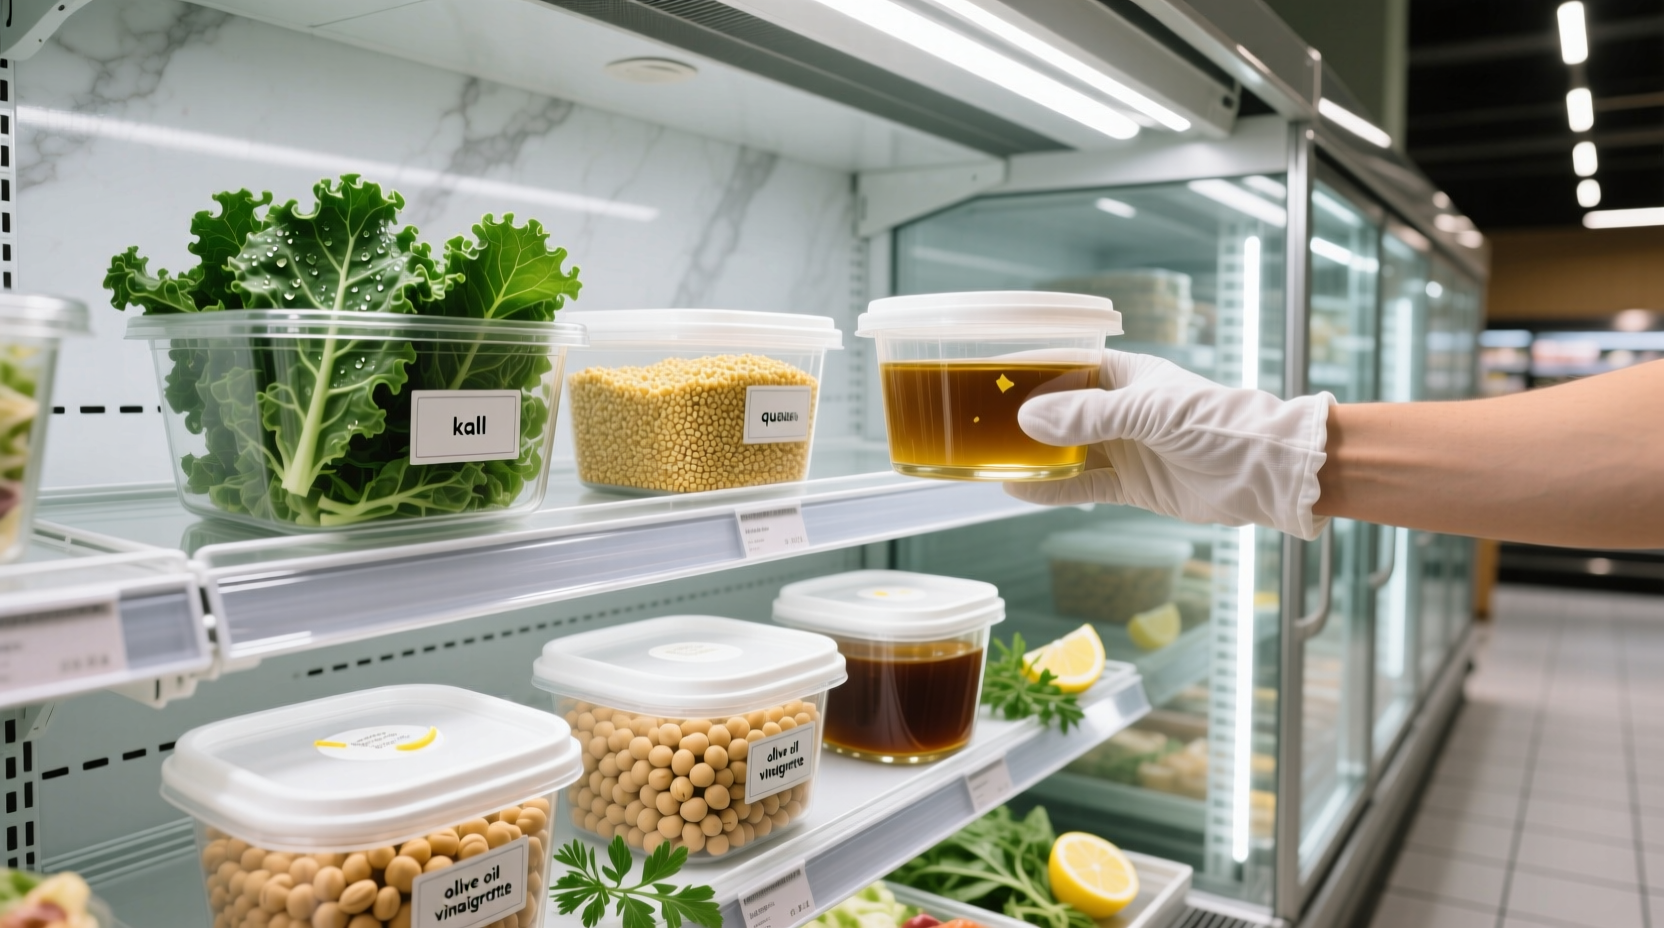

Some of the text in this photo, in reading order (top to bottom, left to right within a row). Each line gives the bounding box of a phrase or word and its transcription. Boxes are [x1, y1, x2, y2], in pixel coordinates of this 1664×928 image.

[453, 415, 486, 436] kall
[444, 864, 500, 899] olive oil
